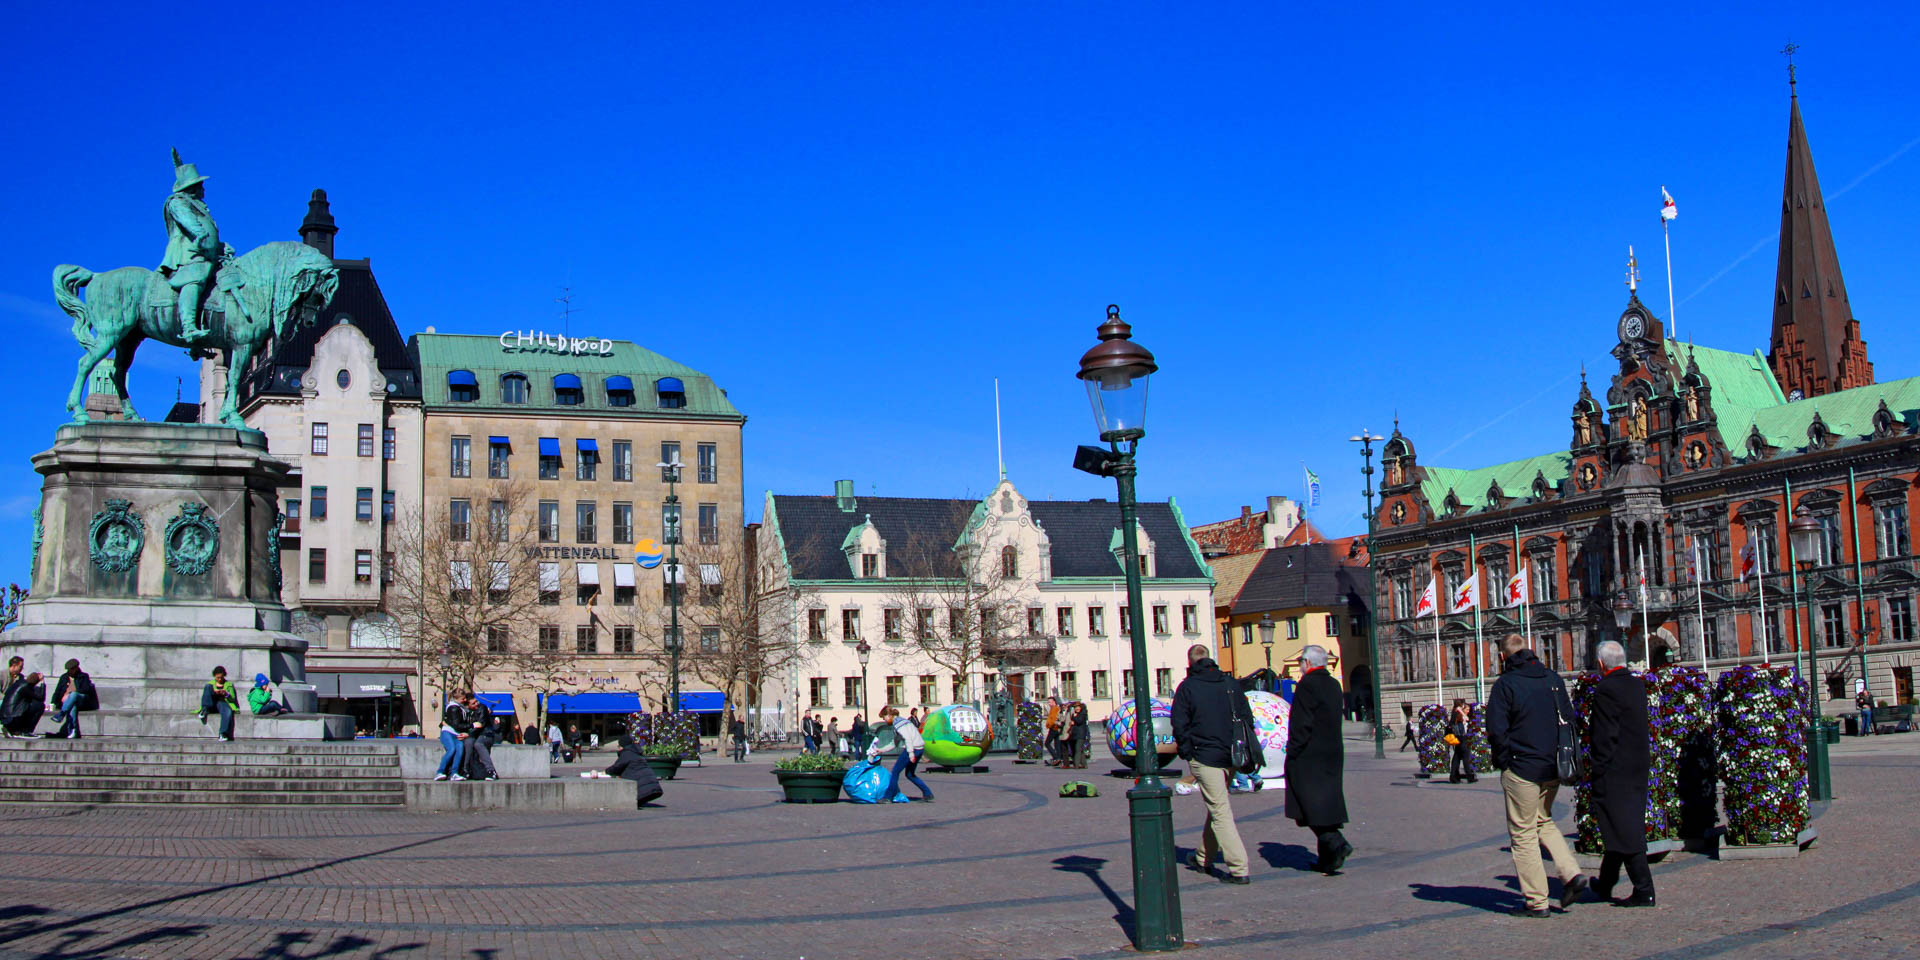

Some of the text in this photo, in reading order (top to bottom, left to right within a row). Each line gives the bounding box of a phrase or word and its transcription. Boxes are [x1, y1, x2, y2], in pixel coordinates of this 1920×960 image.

[499, 329, 613, 355] CHILDHOOD
[523, 545, 620, 560] VATTENFALL
[594, 676, 619, 684] direkt
